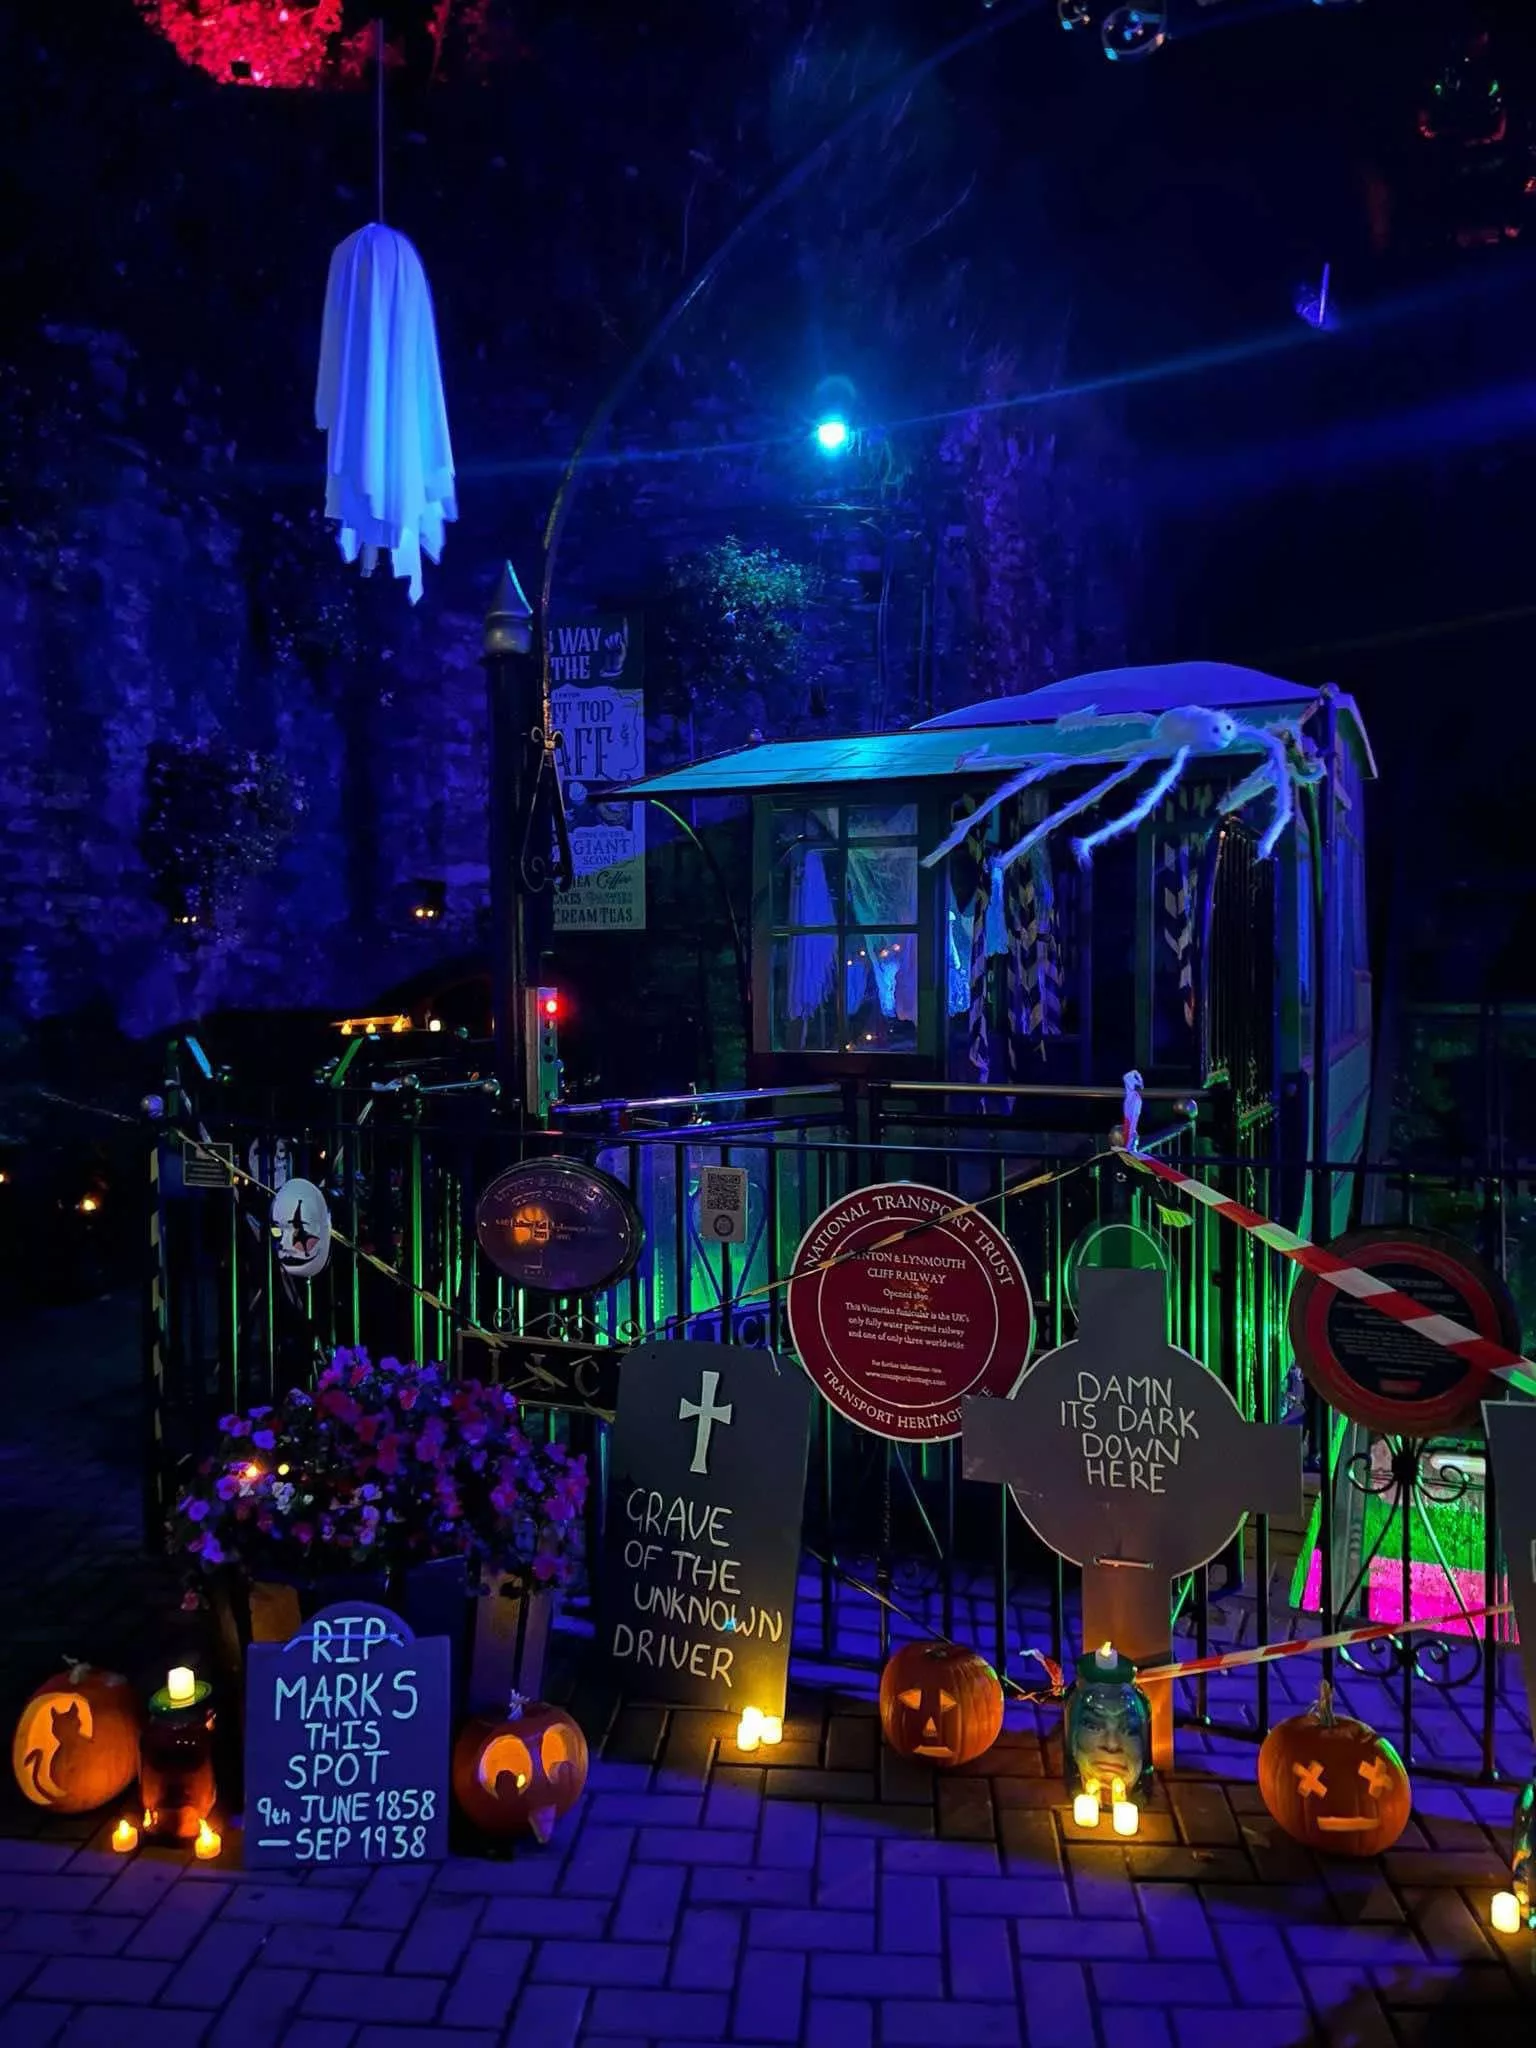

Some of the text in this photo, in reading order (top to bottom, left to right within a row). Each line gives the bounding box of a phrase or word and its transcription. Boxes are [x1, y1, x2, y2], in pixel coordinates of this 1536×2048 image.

[558, 626, 601, 654] WAY
[550, 655, 591, 680] THE
[577, 700, 614, 723] TOP
[573, 839, 631, 855] GIANT
[583, 856, 617, 865] SCONE
[599, 907, 633, 924] TEAS
[804, 1203, 870, 1268] NATIONAL
[974, 1230, 1015, 1287] TRUST
[867, 1267, 947, 1284] CLIFF RAILWAY
[902, 1254, 966, 1270] LYNMOUTH
[883, 1288, 912, 1300] Opened
[845, 1302, 861, 1312] This
[862, 1303, 895, 1315] Victorian
[938, 1312, 950, 1321] the
[848, 1316, 965, 1338] only fully water powered railway
[849, 1329, 862, 1338] and
[863, 1332, 876, 1340] one
[878, 1331, 887, 1341] of
[887, 1334, 903, 1344] only
[904, 1335, 923, 1345] three
[823, 1367, 894, 1425] TRANSPORT
[1077, 1371, 1172, 1408] DAMN
[1061, 1400, 1199, 1440] ITS DARK
[1082, 1432, 1180, 1465] DOWN
[1086, 1459, 1166, 1494] HERE
[626, 1487, 733, 1548] GRAVE
[624, 1539, 741, 1595] OF THE
[633, 1581, 783, 1642] UNKNOWN
[312, 1617, 386, 1664] RIP
[612, 1623, 732, 1688] DRIVER
[304, 1720, 381, 1751] THIS
[284, 1749, 390, 1790] SPOT
[256, 1789, 436, 1827] 9th JUNE 1858
[295, 1827, 350, 1861] SEP
[360, 1825, 427, 1859] 1938
